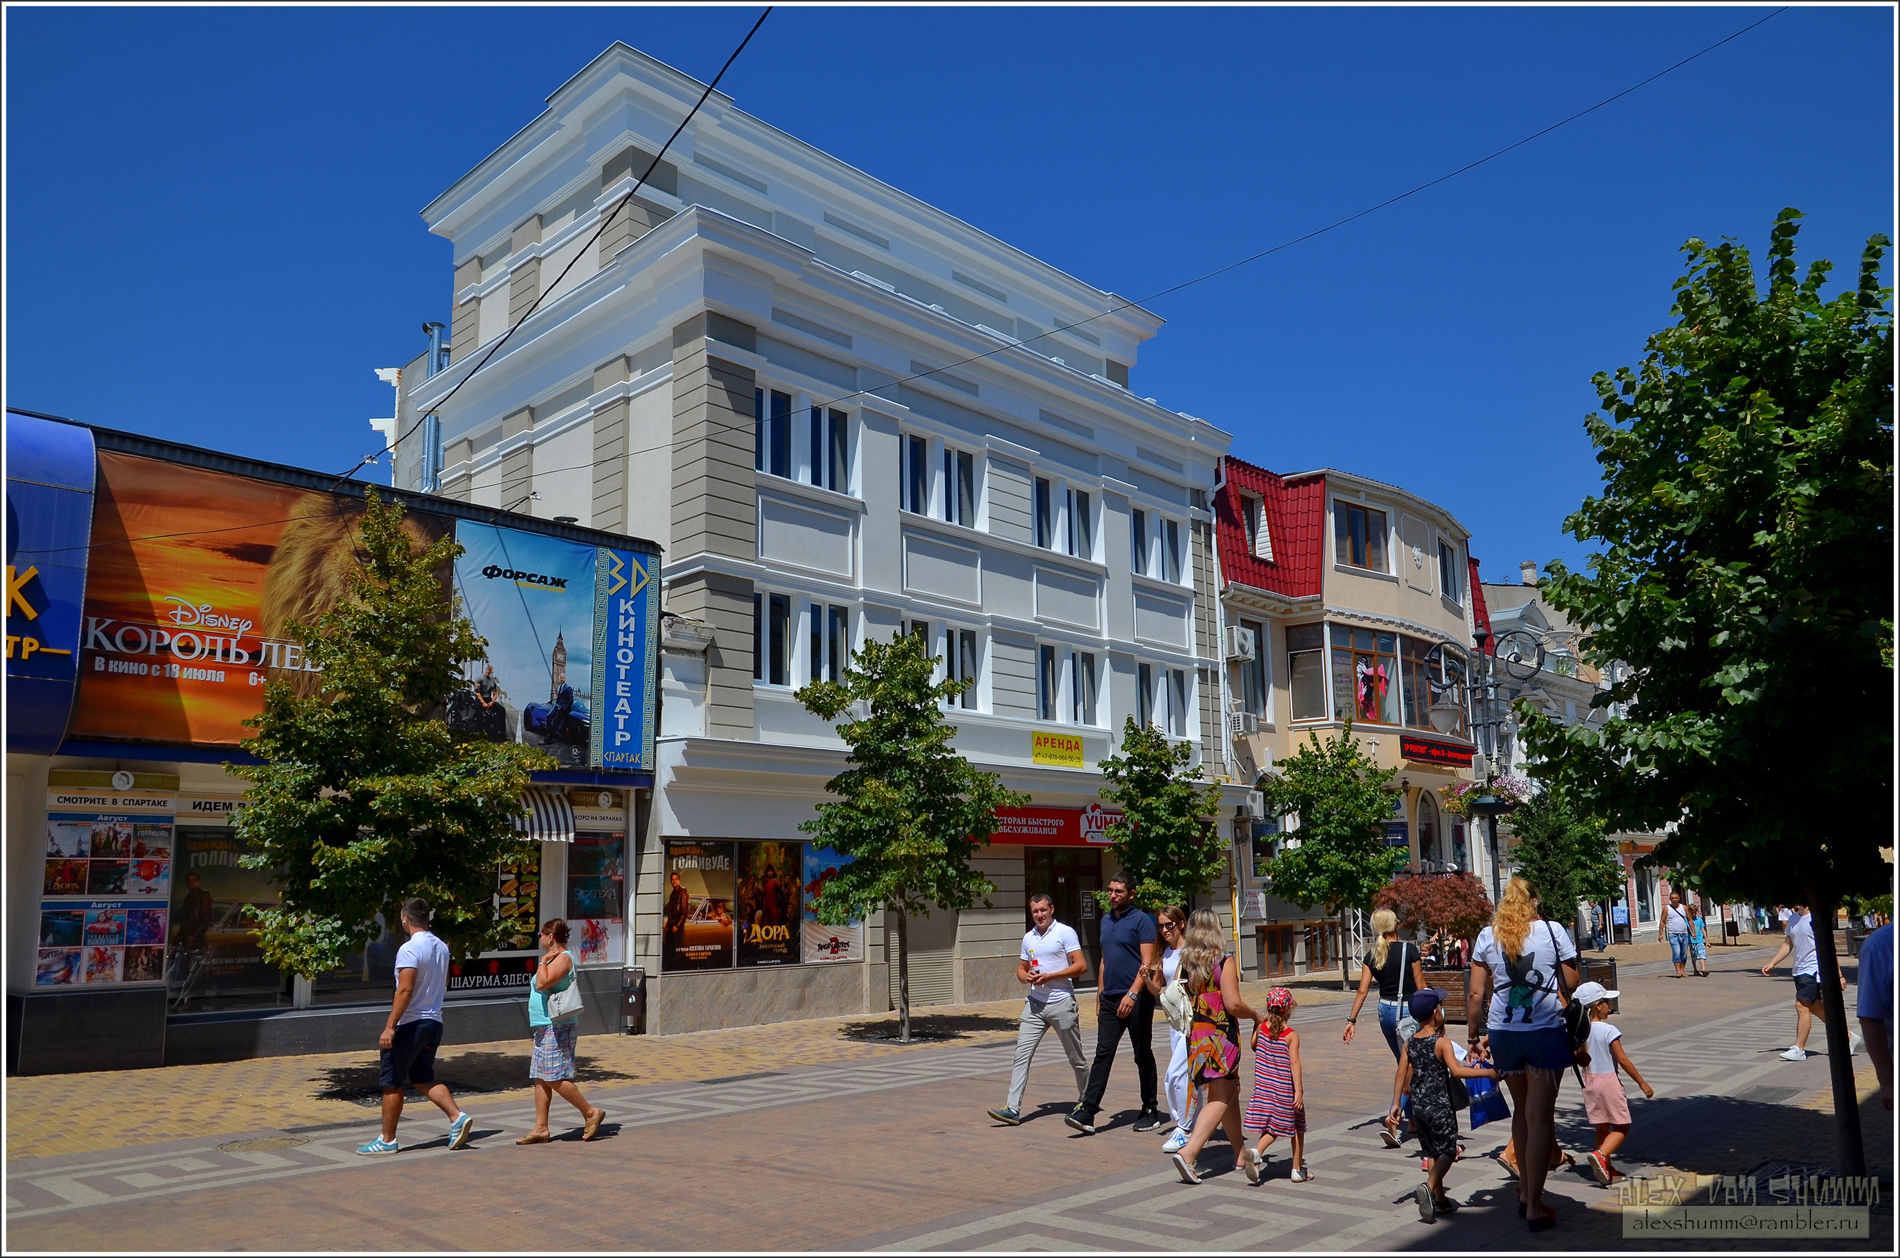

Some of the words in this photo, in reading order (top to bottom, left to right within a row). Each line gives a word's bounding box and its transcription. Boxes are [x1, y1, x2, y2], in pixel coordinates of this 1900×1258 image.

[482, 564, 569, 588] ФОРСАЖ
[84, 616, 250, 666] КОРОЛЬ
[94, 656, 105, 671] В
[108, 659, 149, 678] кино
[151, 664, 161, 678] с
[164, 663, 181, 679] 18
[182, 667, 226, 684] июля
[614, 598, 636, 747] КИНОТЕАТР
[248, 671, 267, 687] 6+
[1035, 736, 1080, 752] АРЕНДА
[604, 751, 641, 764] СПАРТАК
[57, 796, 107, 806] СМОТРИТЕ
[123, 798, 168, 807] СПАРТАКЕ
[193, 801, 233, 812] ИДЕМ
[97, 814, 128, 823] Август
[997, 816, 1026, 826] СТОРАН
[1028, 817, 1064, 827] БЫСТРОГО
[998, 825, 1057, 835] ОБСЛУЖИВАНИЯ
[186, 839, 232, 851] ОДНАЖДЫ
[669, 846, 701, 856] ОДНАЖДЫ
[672, 855, 730, 871] ГОЛЛИВУДЕ
[91, 902, 122, 911] Август
[749, 923, 791, 944] ДОРА
[829, 937, 839, 954] 2
[451, 975, 501, 989] ШАУРМА
